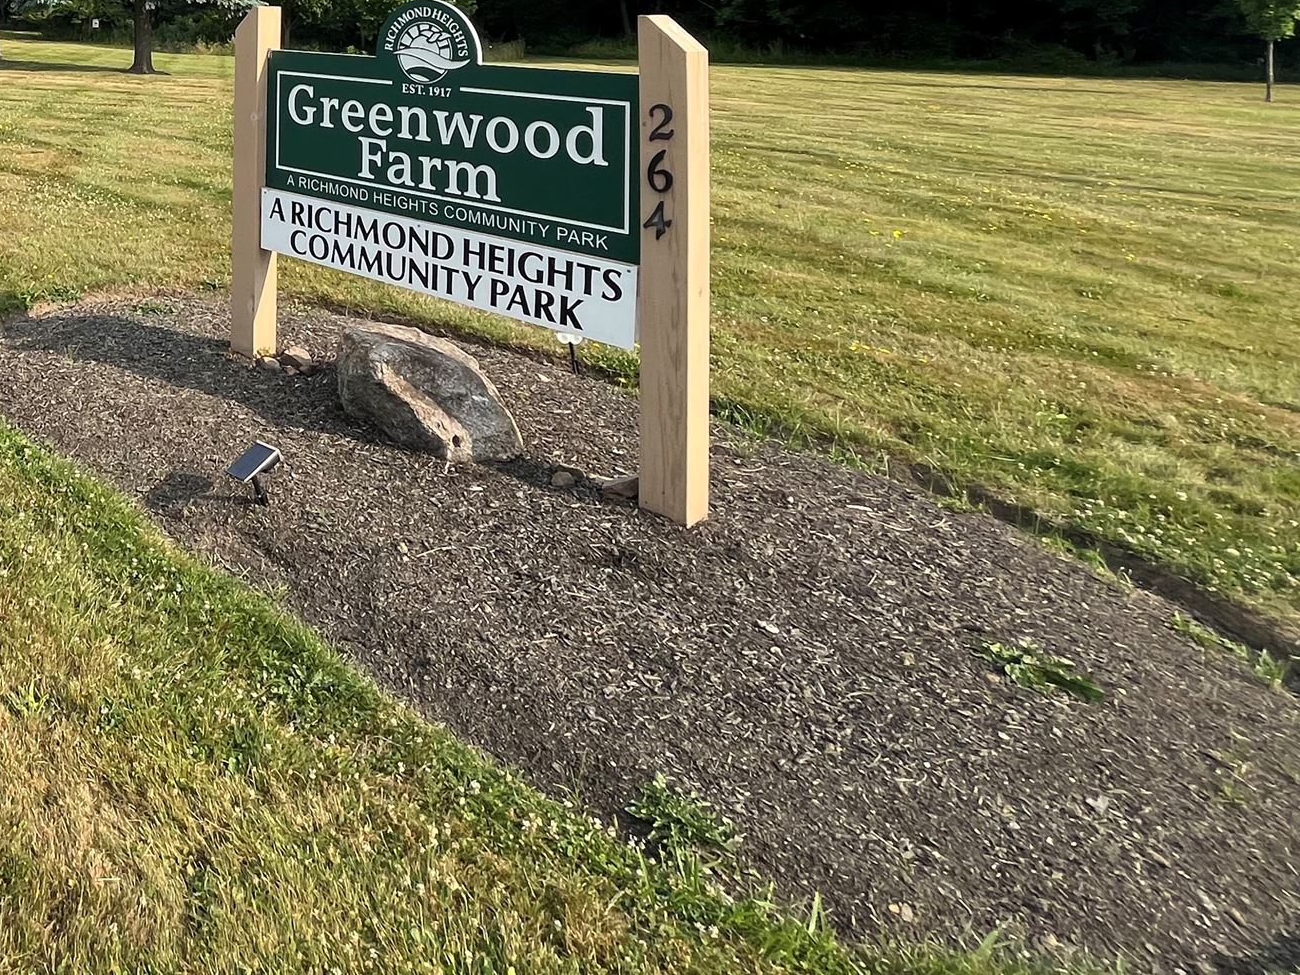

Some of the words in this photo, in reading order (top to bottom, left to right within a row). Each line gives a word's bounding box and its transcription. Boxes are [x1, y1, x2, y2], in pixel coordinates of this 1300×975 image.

[384, 7, 431, 51] RICHMOND
[431, 8, 468, 57] HEIGHTS
[287, 84, 609, 167] Greenwood
[402, 83, 426, 95] EST.
[429, 86, 452, 98] 1917
[357, 136, 502, 203] Farm
[269, 197, 286, 222] A
[291, 201, 455, 261] RICHMOND
[463, 238, 623, 302] HEIGHTS
[286, 174, 295, 187] A
[298, 176, 369, 201] RICHMOND
[373, 190, 439, 216] HEIGHTS
[444, 205, 550, 238] COMMUNITY
[556, 227, 609, 251] PARK
[290, 229, 483, 301] COMMUNITY
[490, 278, 584, 330] PARK
